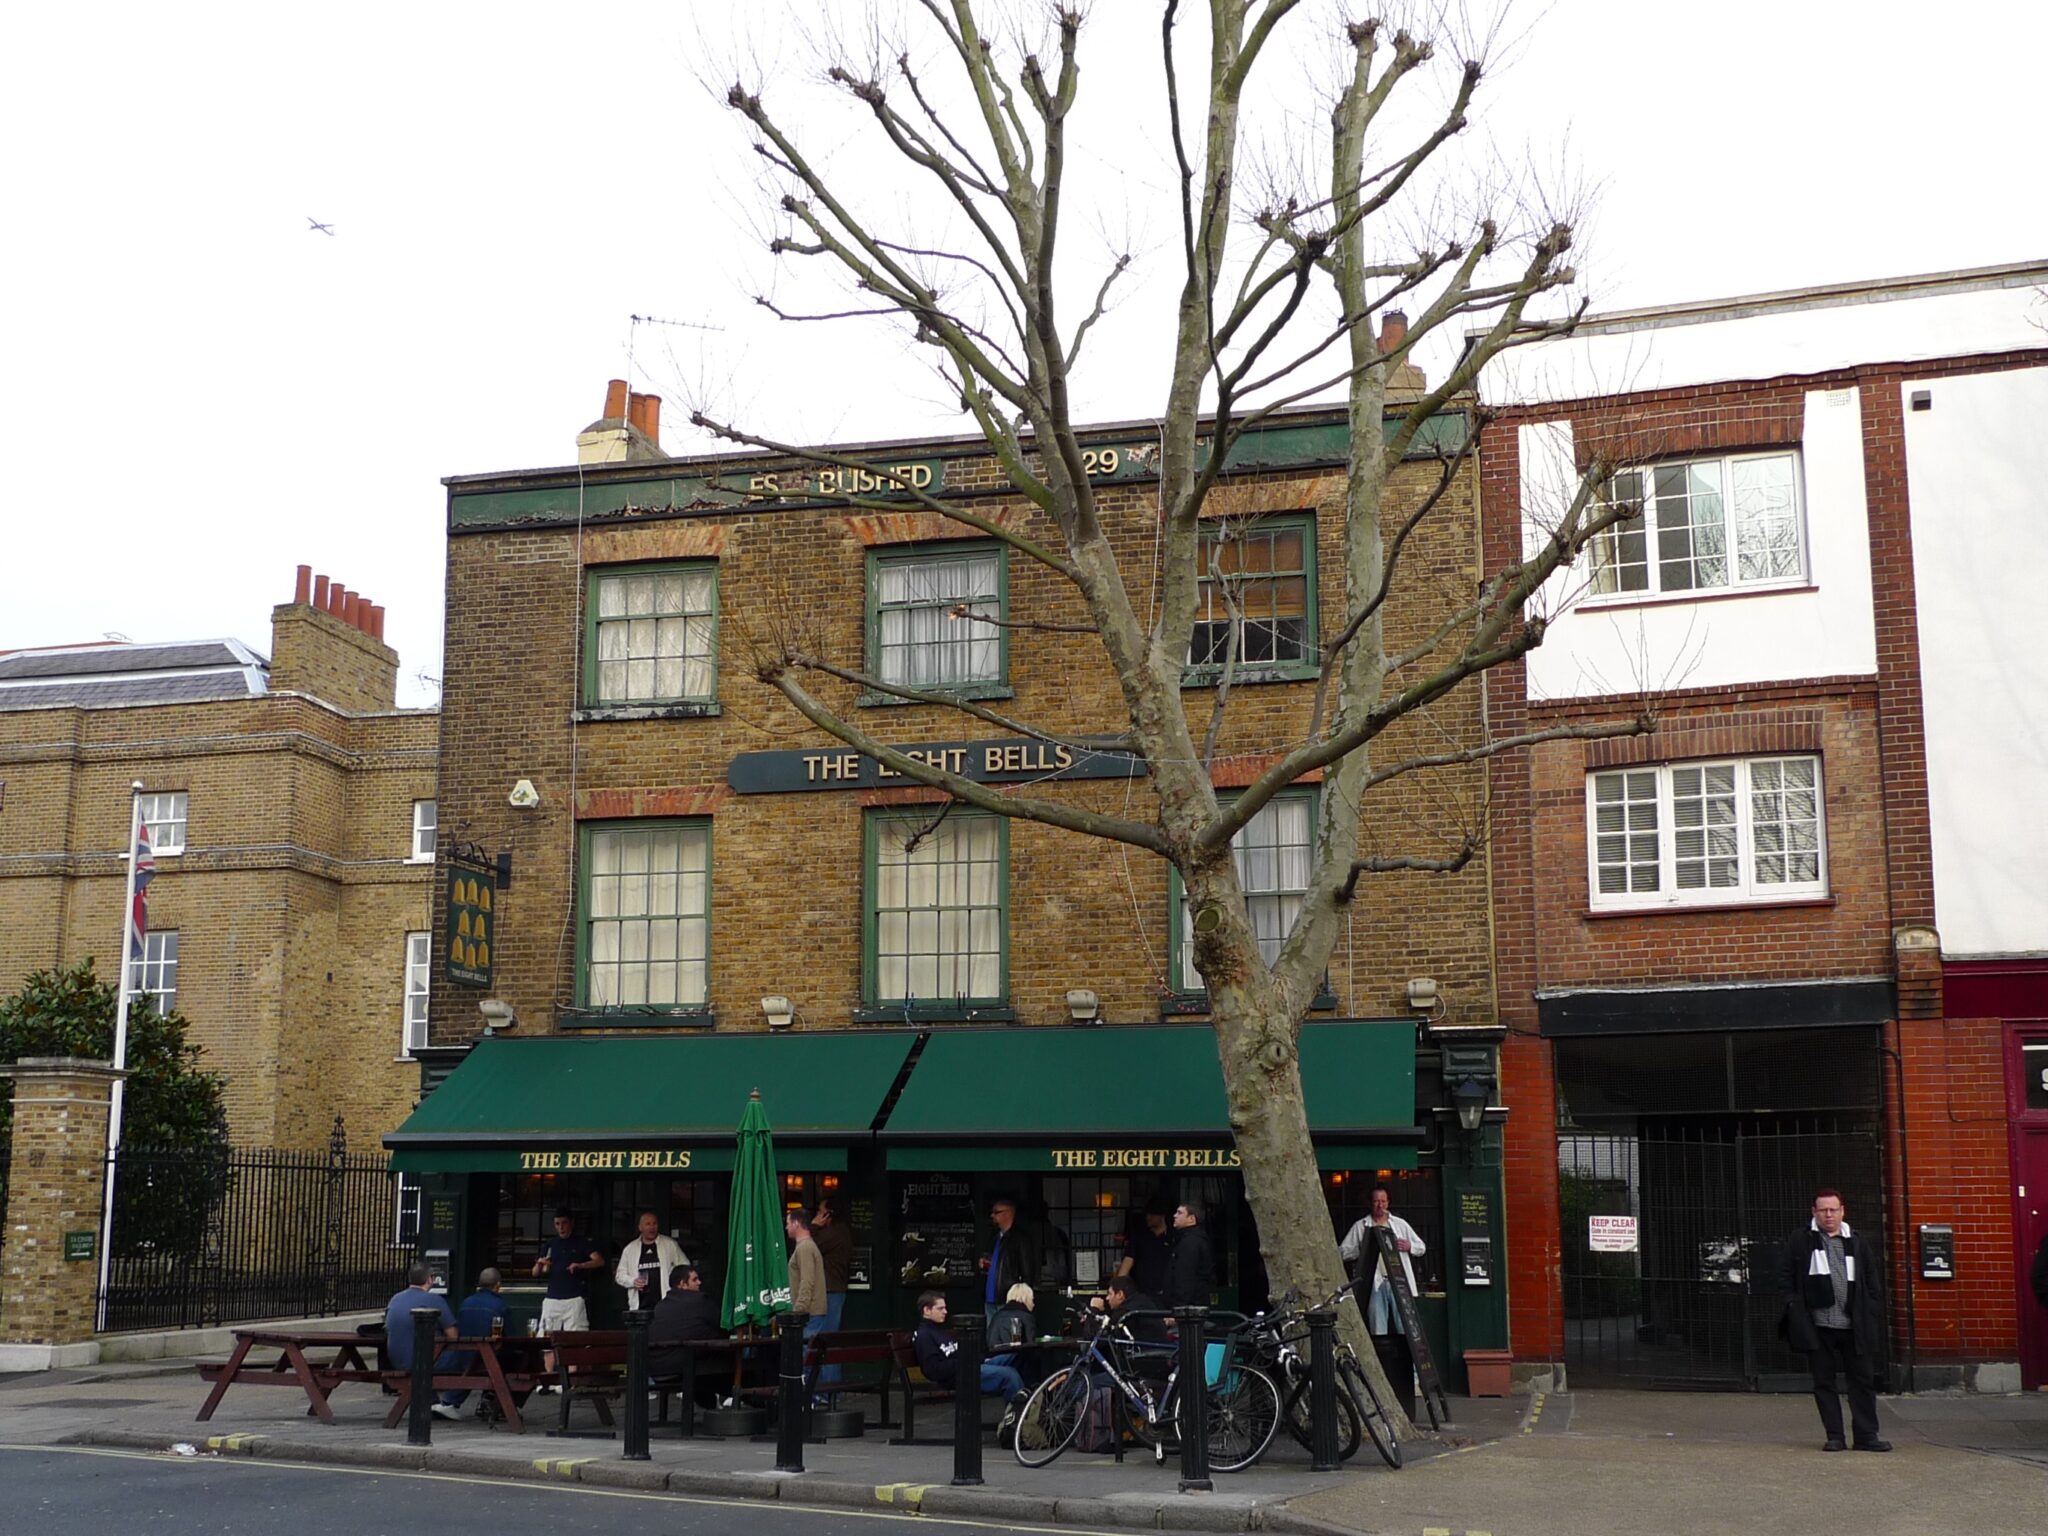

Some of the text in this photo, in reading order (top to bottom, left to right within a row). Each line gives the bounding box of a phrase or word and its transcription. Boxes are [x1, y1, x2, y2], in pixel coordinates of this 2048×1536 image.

[803, 754, 859, 781] THE
[985, 744, 1073, 773] BELLS
[520, 1151, 691, 1169] THE EIGHT BELLS
[1051, 1149, 1241, 1167] THE EIGHT BELLS
[1591, 1217, 1635, 1228] KEEP CLEAR
[638, 1261, 661, 1270] AMSUN
